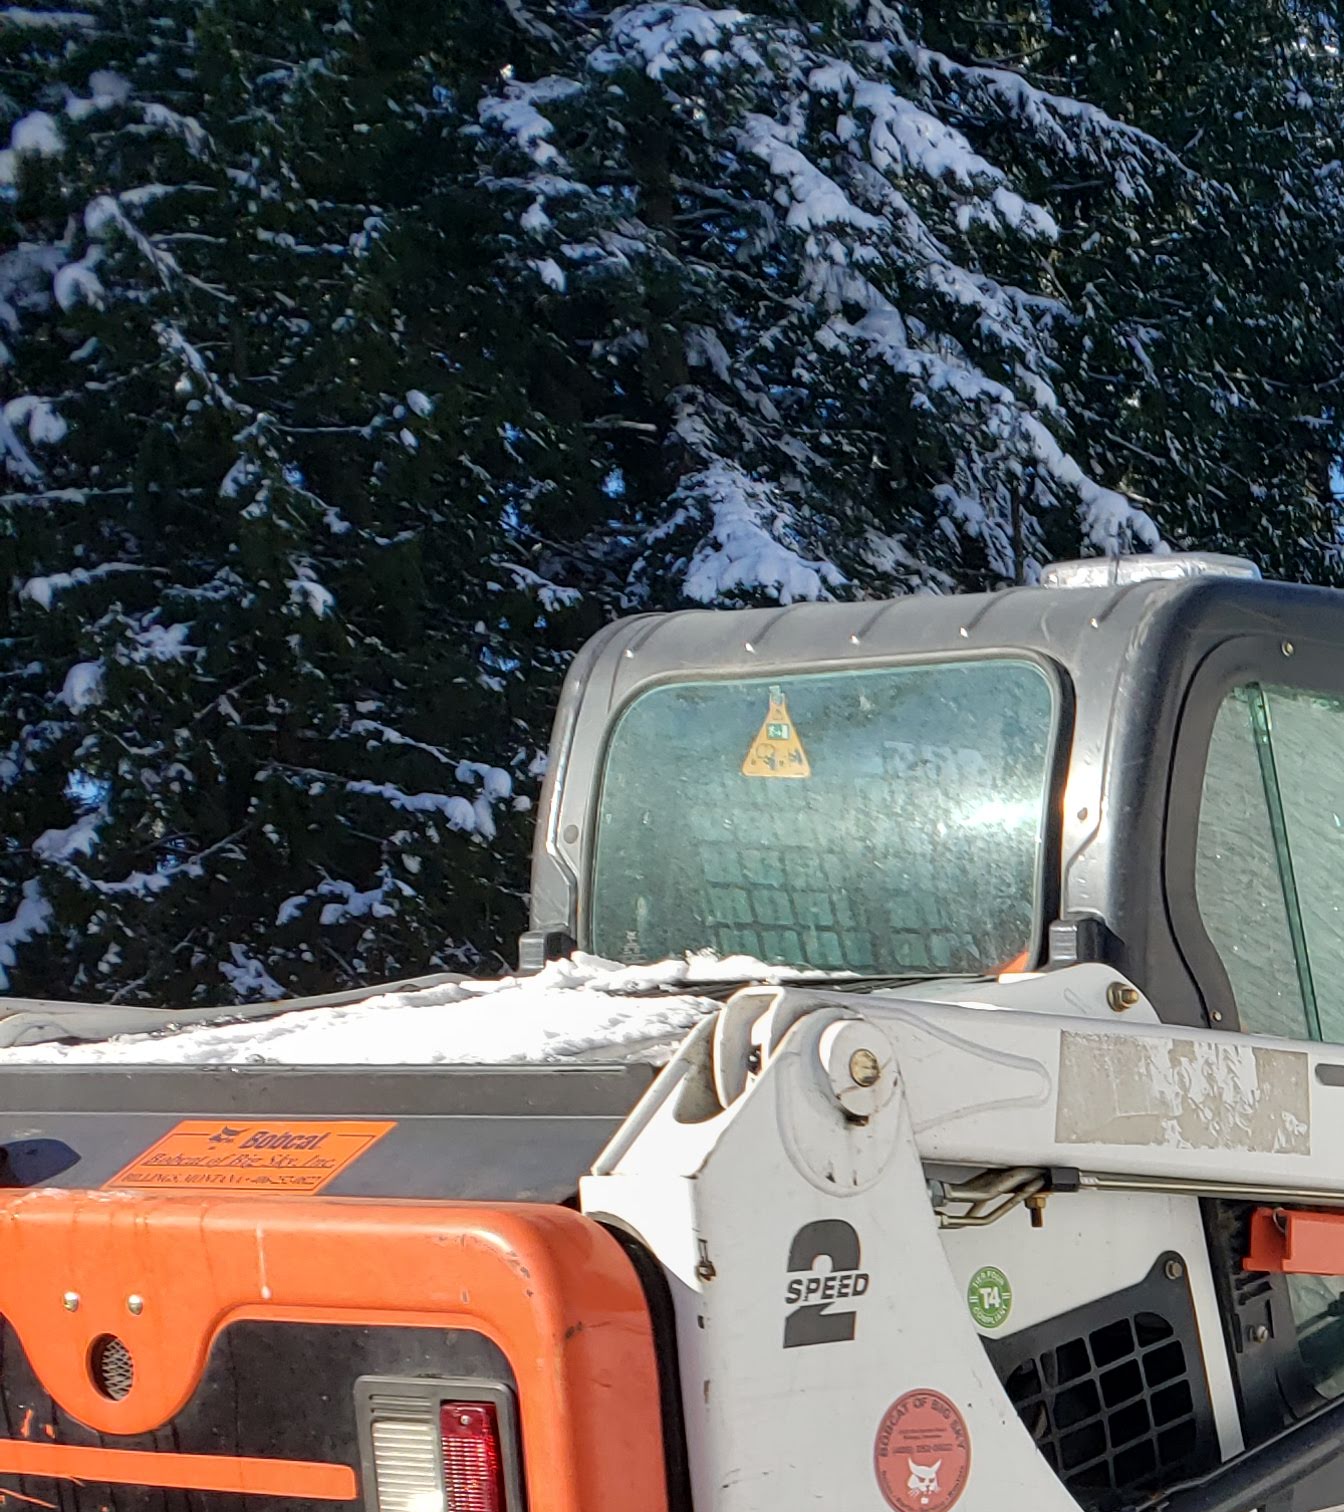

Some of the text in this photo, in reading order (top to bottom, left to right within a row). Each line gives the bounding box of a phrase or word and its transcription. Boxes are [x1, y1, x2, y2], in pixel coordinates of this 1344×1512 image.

[239, 1131, 331, 1150] Bobcat
[785, 1273, 869, 1304] SPEED
[979, 1286, 1001, 1309] T4
[879, 1403, 908, 1457] BOBCAT
[912, 1397, 928, 1408] OF
